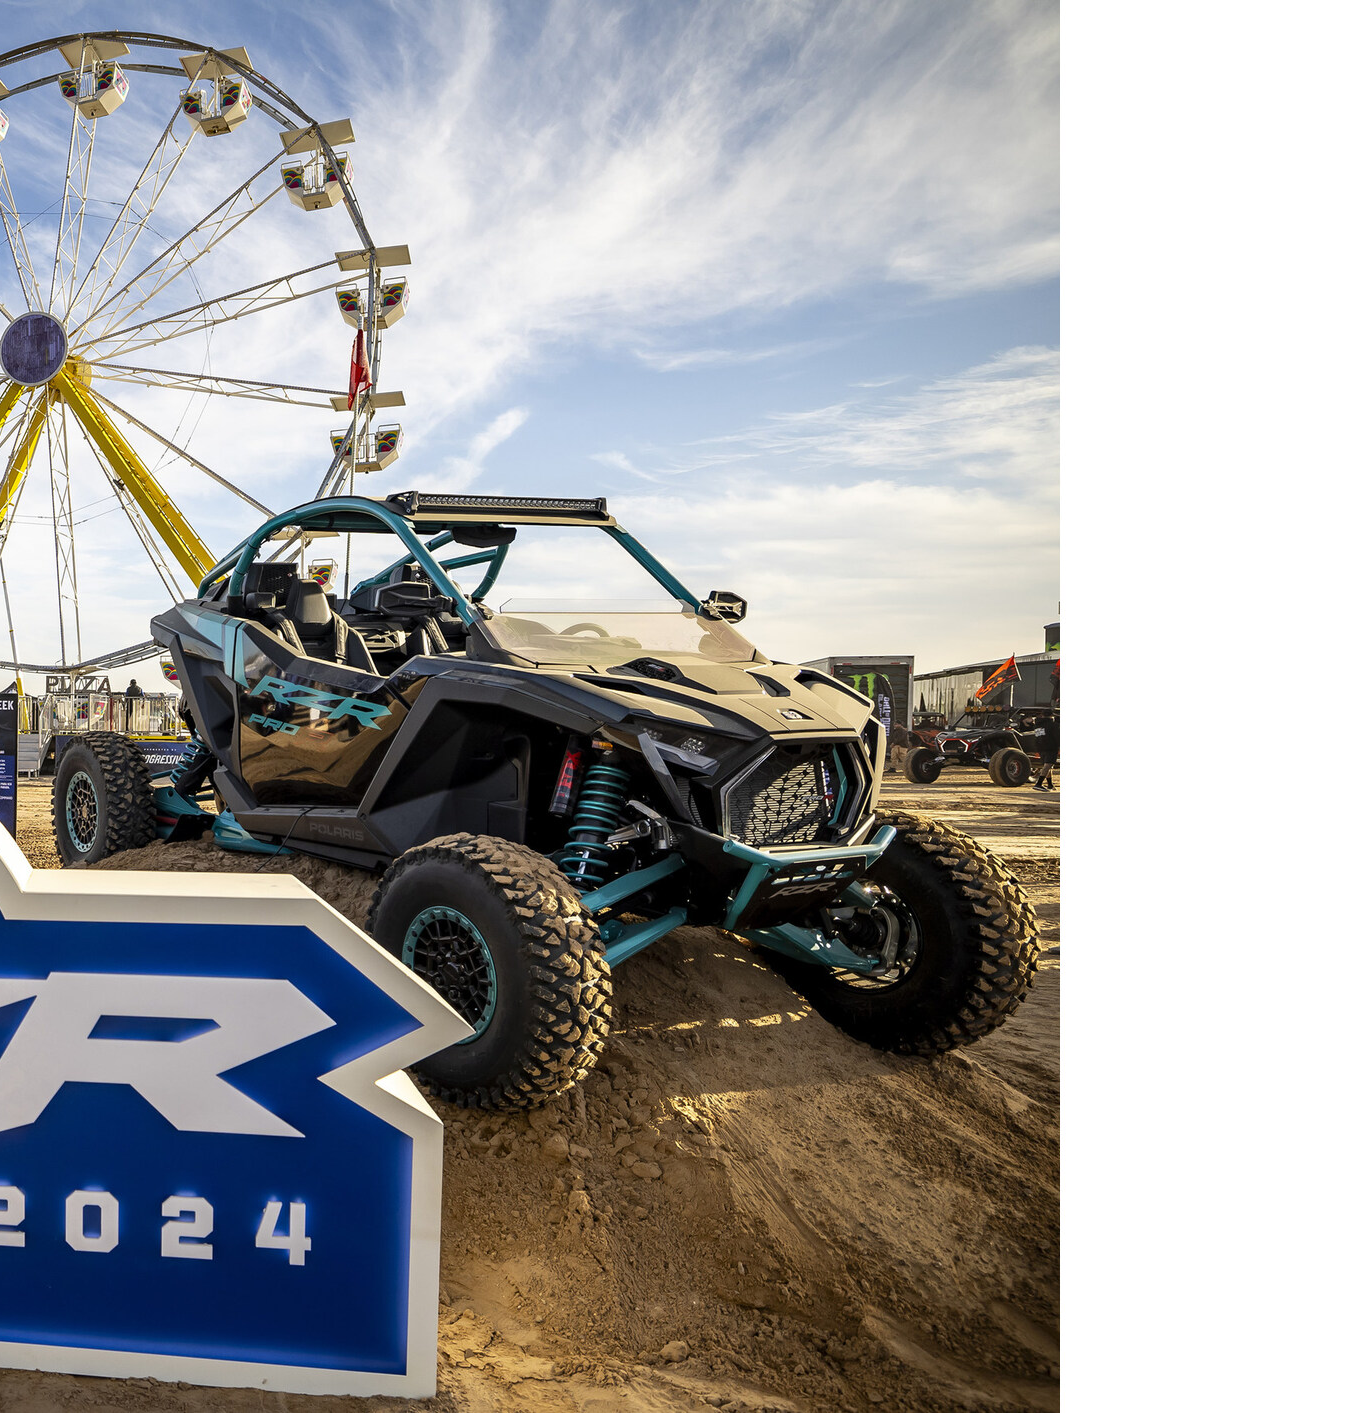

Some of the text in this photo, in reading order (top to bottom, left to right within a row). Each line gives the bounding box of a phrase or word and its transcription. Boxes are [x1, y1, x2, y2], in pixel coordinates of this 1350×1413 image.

[250, 675, 392, 730] RZR
[248, 714, 300, 735] PRO
[142, 755, 185, 765] OGRESSIV
[309, 822, 365, 841] POLARIS
[769, 882, 836, 899] RZR
